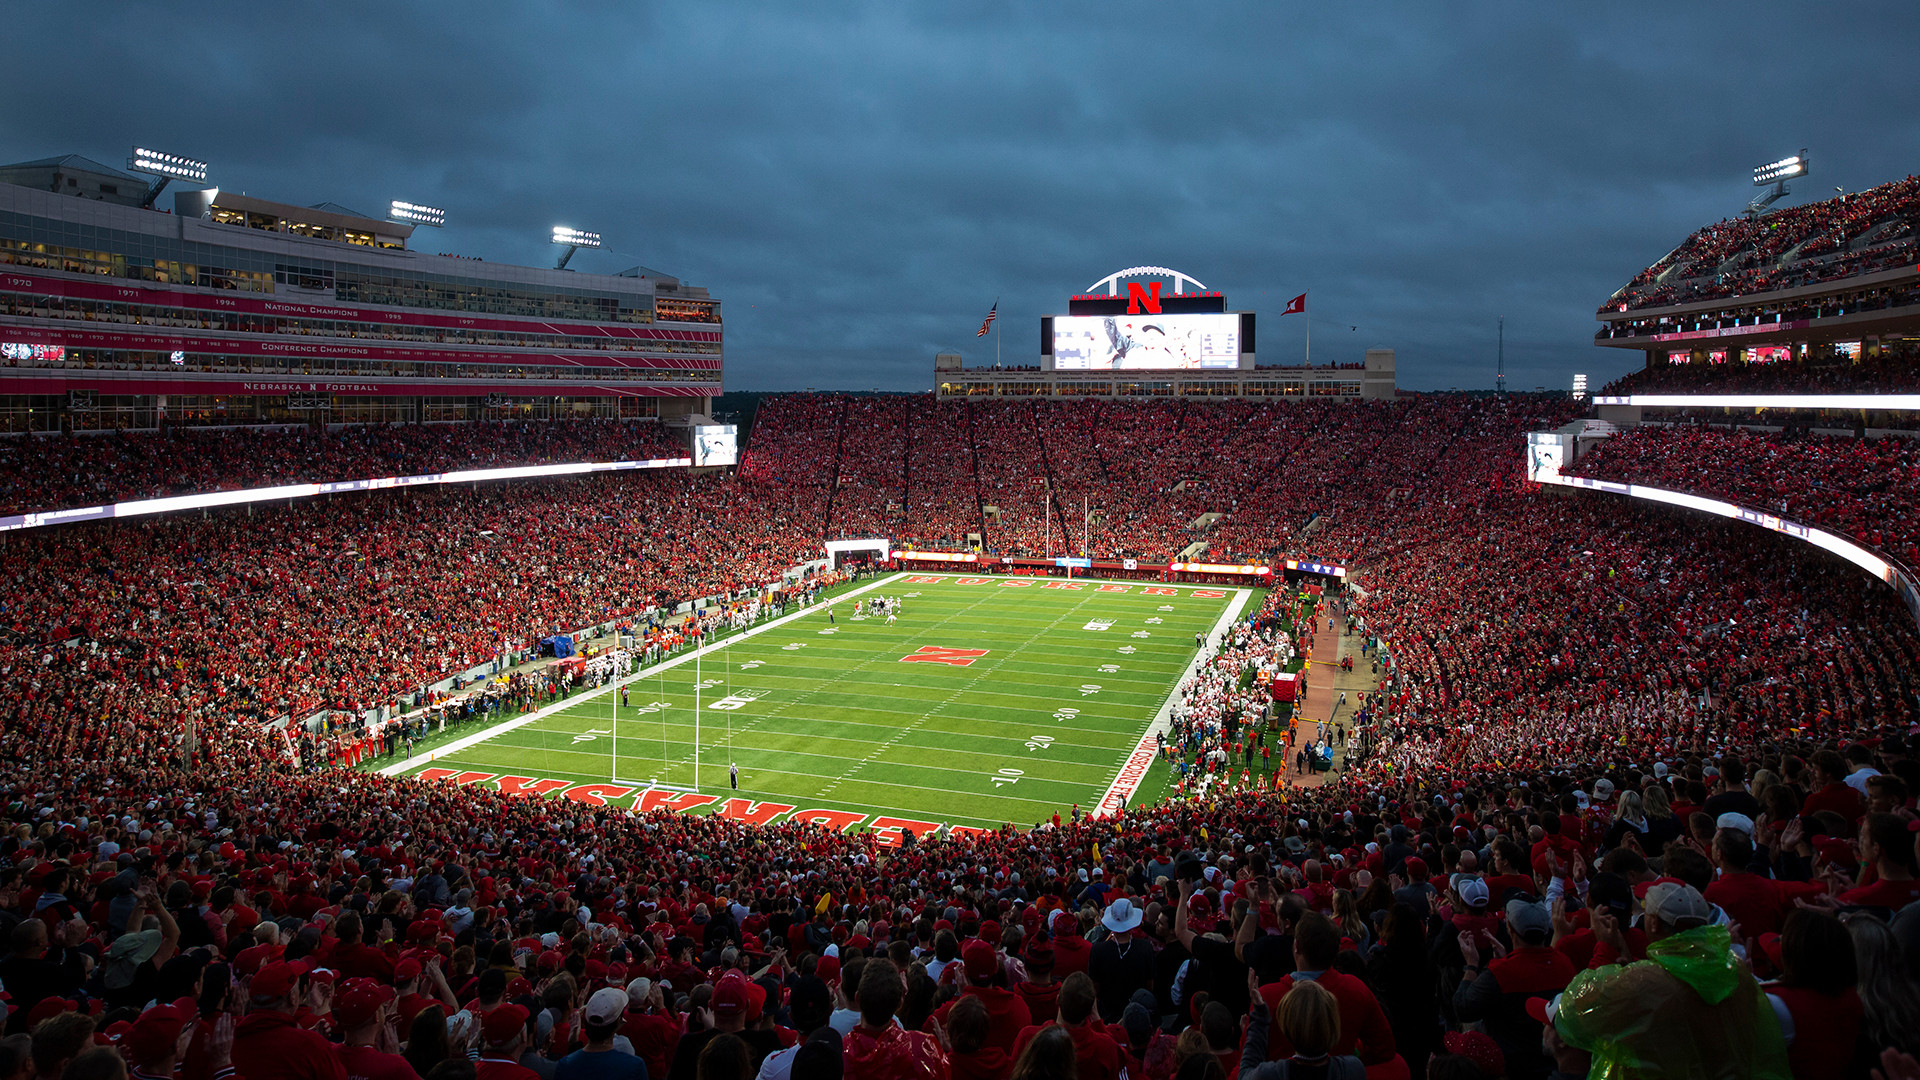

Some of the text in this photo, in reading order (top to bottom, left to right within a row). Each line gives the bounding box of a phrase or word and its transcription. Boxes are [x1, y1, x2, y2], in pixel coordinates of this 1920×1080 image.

[7, 278, 32, 287] 1970
[118, 289, 140, 297] 1971
[1072, 291, 1222, 301] MEMORIAL STADIUM
[1126, 281, 1162, 314] N
[264, 302, 358, 317] NATIONAL CHAMPIONS
[261, 343, 368, 355] CONFERENCE CHAMPIONS
[244, 382, 302, 391] NEBRASKA
[309, 383, 316, 391] N
[325, 383, 379, 391] FOOTBALL
[899, 575, 1227, 598] HUSKERS
[899, 645, 990, 667] N
[1052, 707, 1081, 720] 30
[573, 728, 612, 741] 10
[1024, 735, 1055, 749] 20
[1116, 752, 1153, 786] OSBORNE
[991, 768, 1025, 784] 10
